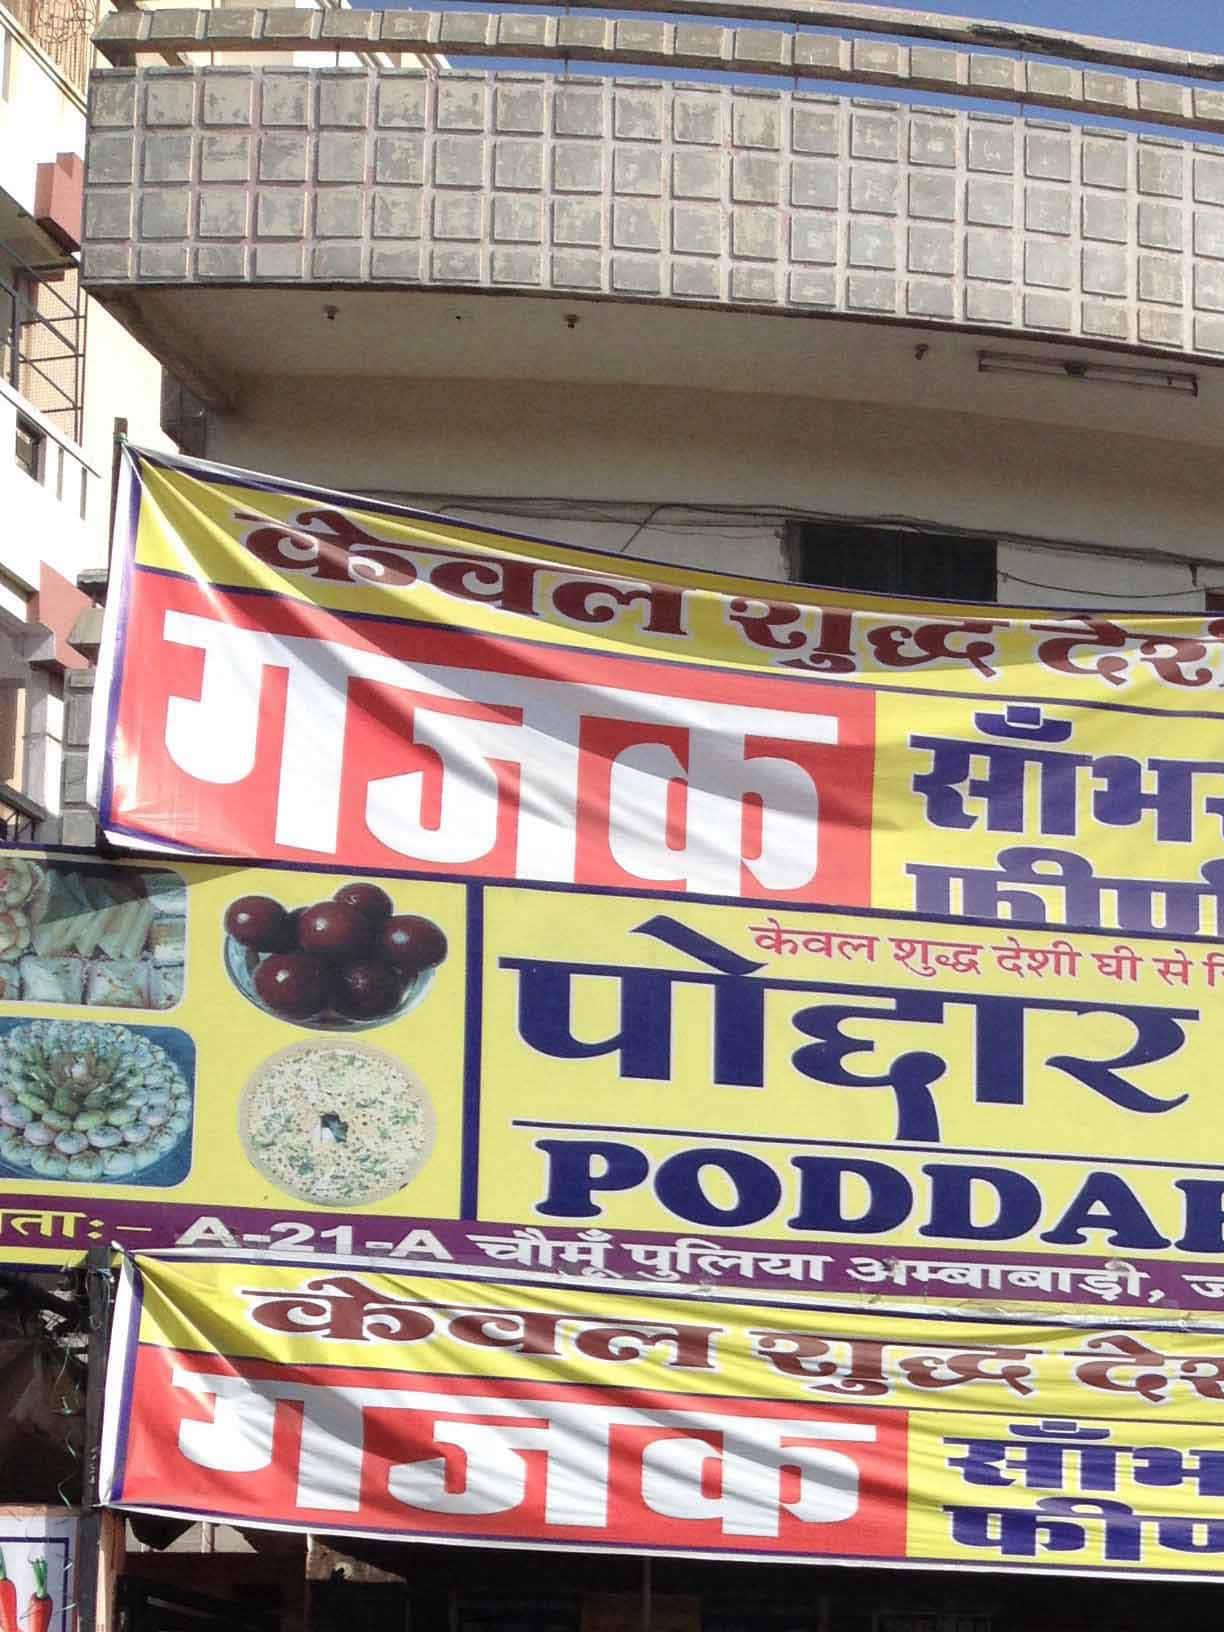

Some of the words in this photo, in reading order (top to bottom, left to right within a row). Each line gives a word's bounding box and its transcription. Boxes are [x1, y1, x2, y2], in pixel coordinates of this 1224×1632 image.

[234, 508, 689, 635] केवल
[163, 611, 838, 899] गजक
[750, 918, 880, 962] केवल
[991, 936, 1083, 978] देशी
[1092, 945, 1144, 984] घी
[1152, 949, 1193, 985] से
[498, 914, 1200, 1142] पोद्दार
[175, 1215, 454, 1262] A-21-A
[622, 1237, 834, 1282] पुलिया
[241, 1276, 723, 1370] केवल
[171, 1369, 878, 1540] गजक
